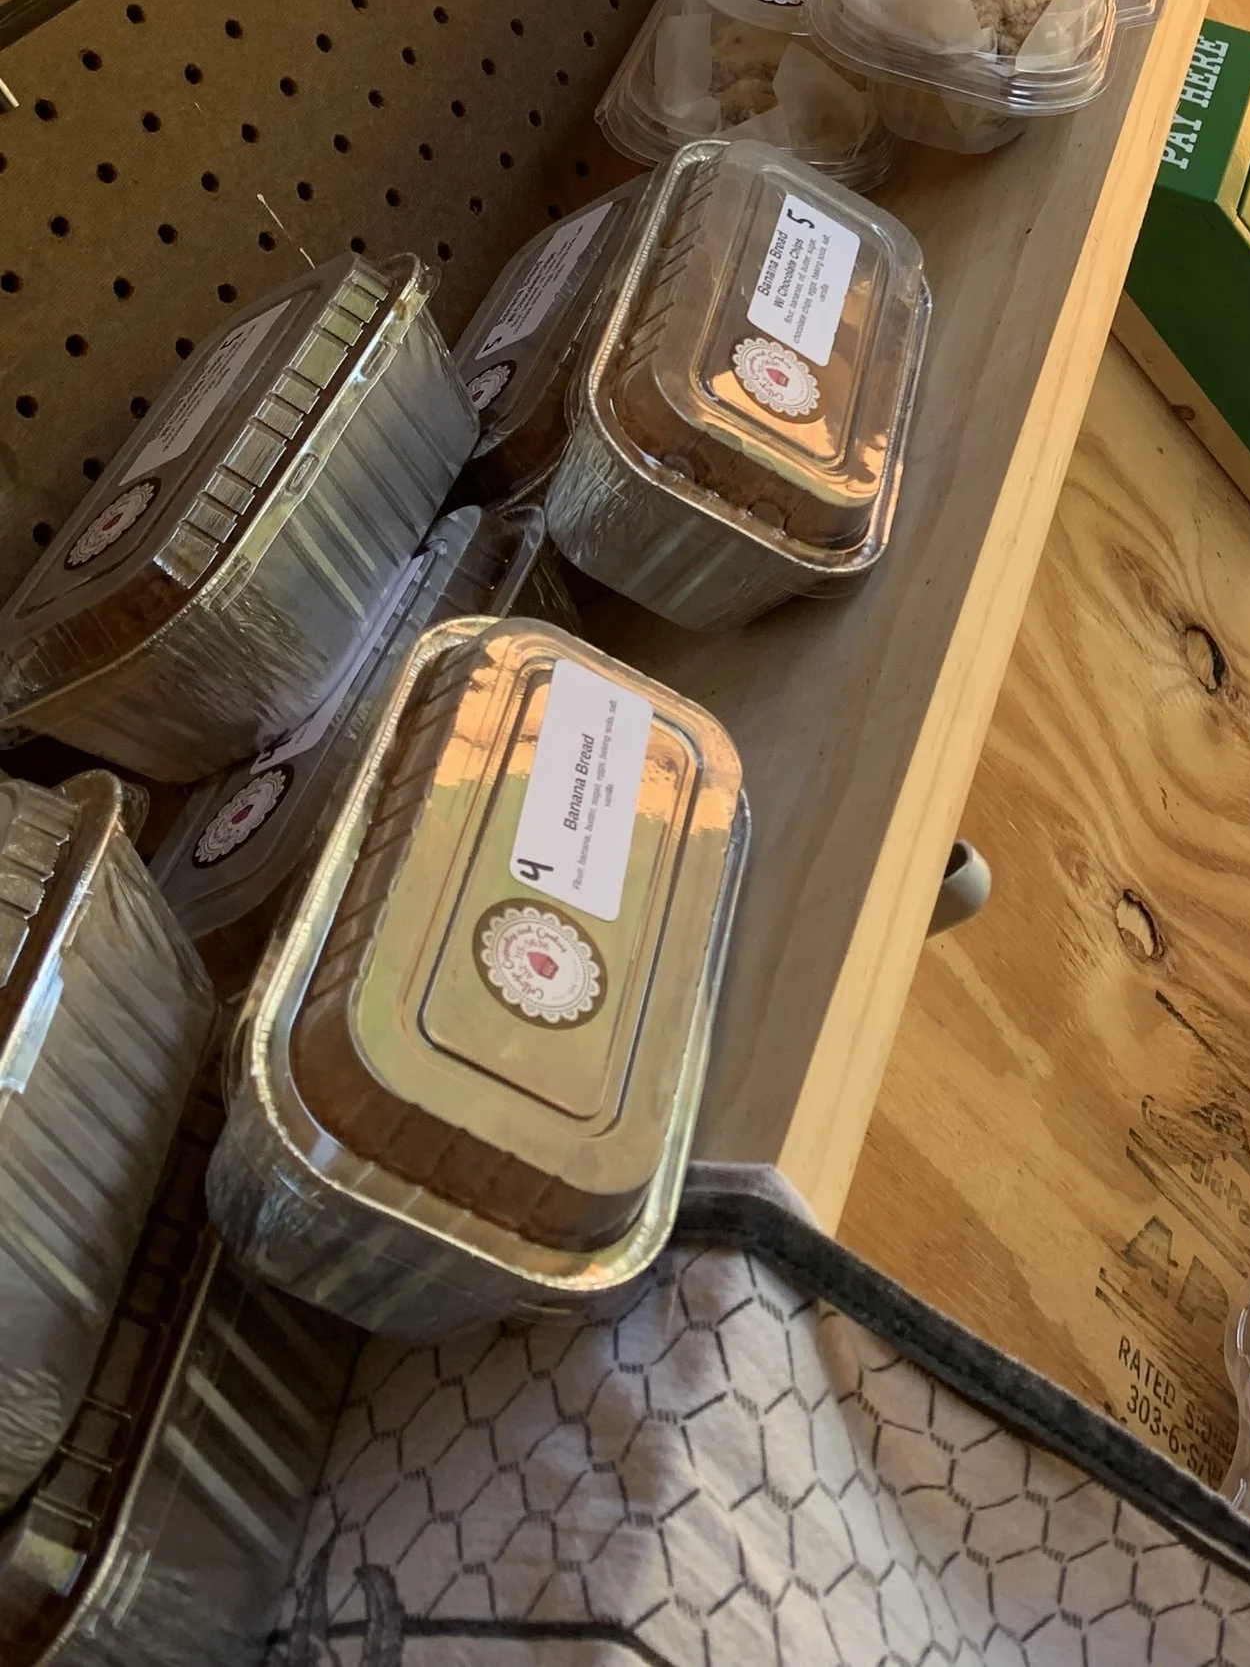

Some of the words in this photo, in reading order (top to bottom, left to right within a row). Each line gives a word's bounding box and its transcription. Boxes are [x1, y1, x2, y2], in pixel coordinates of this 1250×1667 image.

[1179, 34, 1229, 107] HERE
[1161, 110, 1202, 169] PAY
[784, 208, 817, 229] 5
[756, 258, 778, 296] Banana
[769, 230, 788, 259] Bread
[777, 258, 796, 297] Chocolate
[789, 237, 804, 260] Chips
[561, 775, 586, 830] Banana
[574, 732, 594, 775] Bread
[512, 856, 554, 885] 4
[1123, 1335, 1175, 1408] RATED
